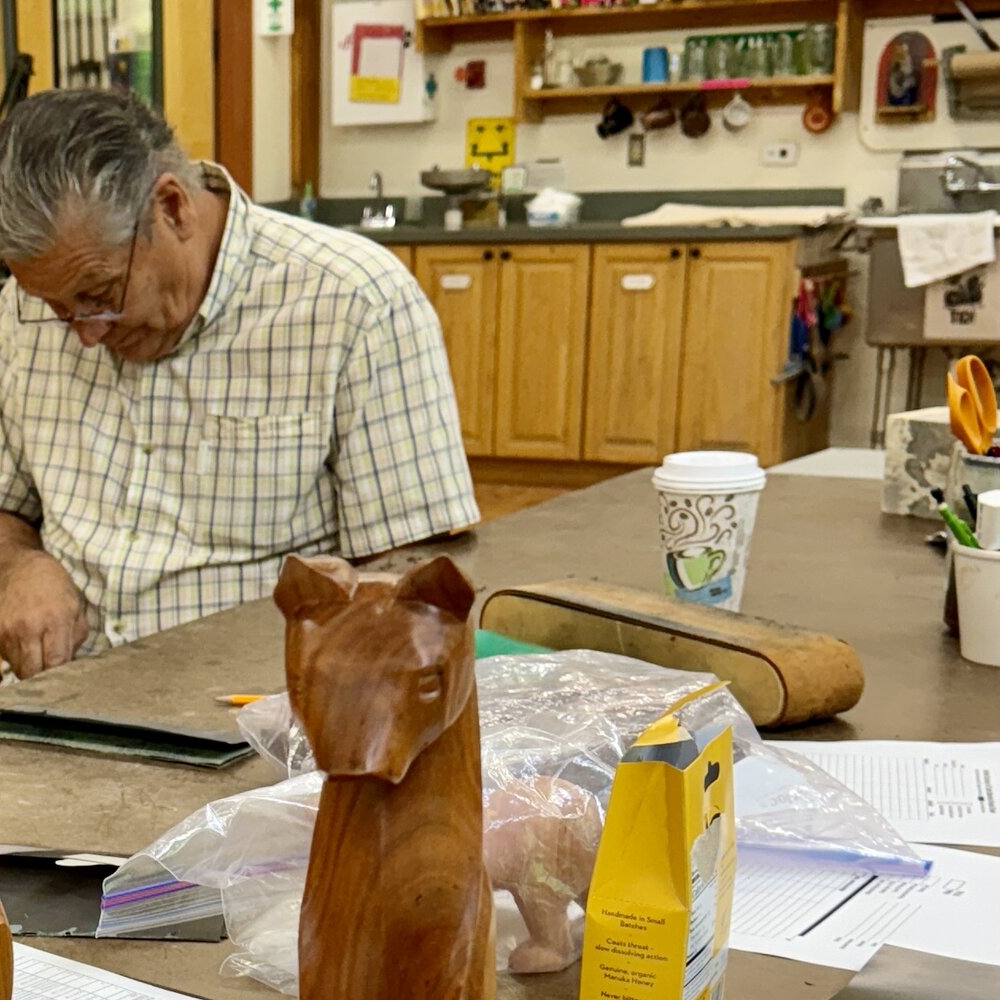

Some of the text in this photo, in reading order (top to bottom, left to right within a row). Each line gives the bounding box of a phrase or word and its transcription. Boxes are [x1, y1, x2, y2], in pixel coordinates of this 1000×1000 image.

[601, 909, 637, 921] Handmade
[647, 916, 666, 926] Small
[620, 920, 647, 931] Batches
[606, 937, 648, 951] Coats throat
[595, 943, 668, 961] slow dissolving action
[604, 973, 654, 988] Manuka Honey
[631, 970, 657, 980] organic
[601, 991, 620, 1000] Never
